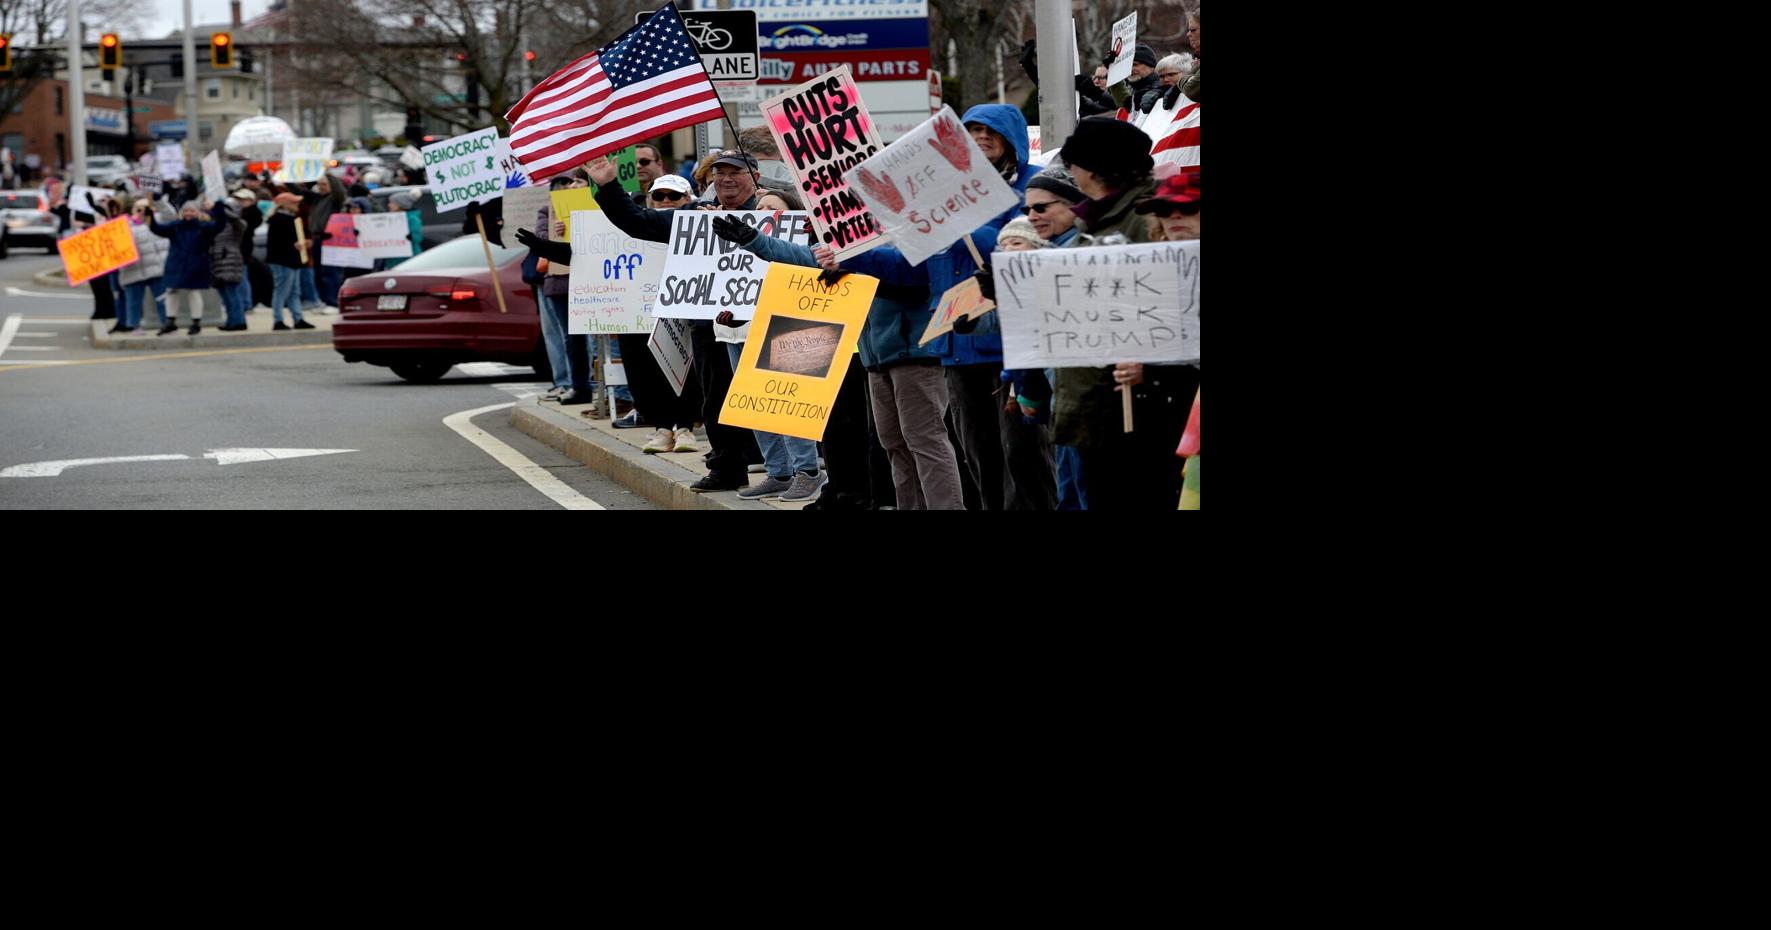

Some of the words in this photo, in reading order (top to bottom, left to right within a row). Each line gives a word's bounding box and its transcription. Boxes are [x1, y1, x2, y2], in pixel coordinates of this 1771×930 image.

[859, 60, 919, 75] PARTS
[783, 76, 848, 131] CUTS
[423, 133, 496, 166] DEMOCRACY
[783, 106, 867, 170] HURT
[882, 141, 922, 171] HANDS
[450, 160, 476, 180] NOT
[717, 254, 753, 273] OUR
[660, 272, 716, 306] SOCIAL
[788, 274, 852, 297] HANDS
[799, 296, 832, 312] OFF
[1044, 306, 1164, 324] MUSK
[1042, 326, 1176, 353] TRUMP
[764, 379, 799, 397] OUR
[728, 394, 829, 420] CONSTITUTION
